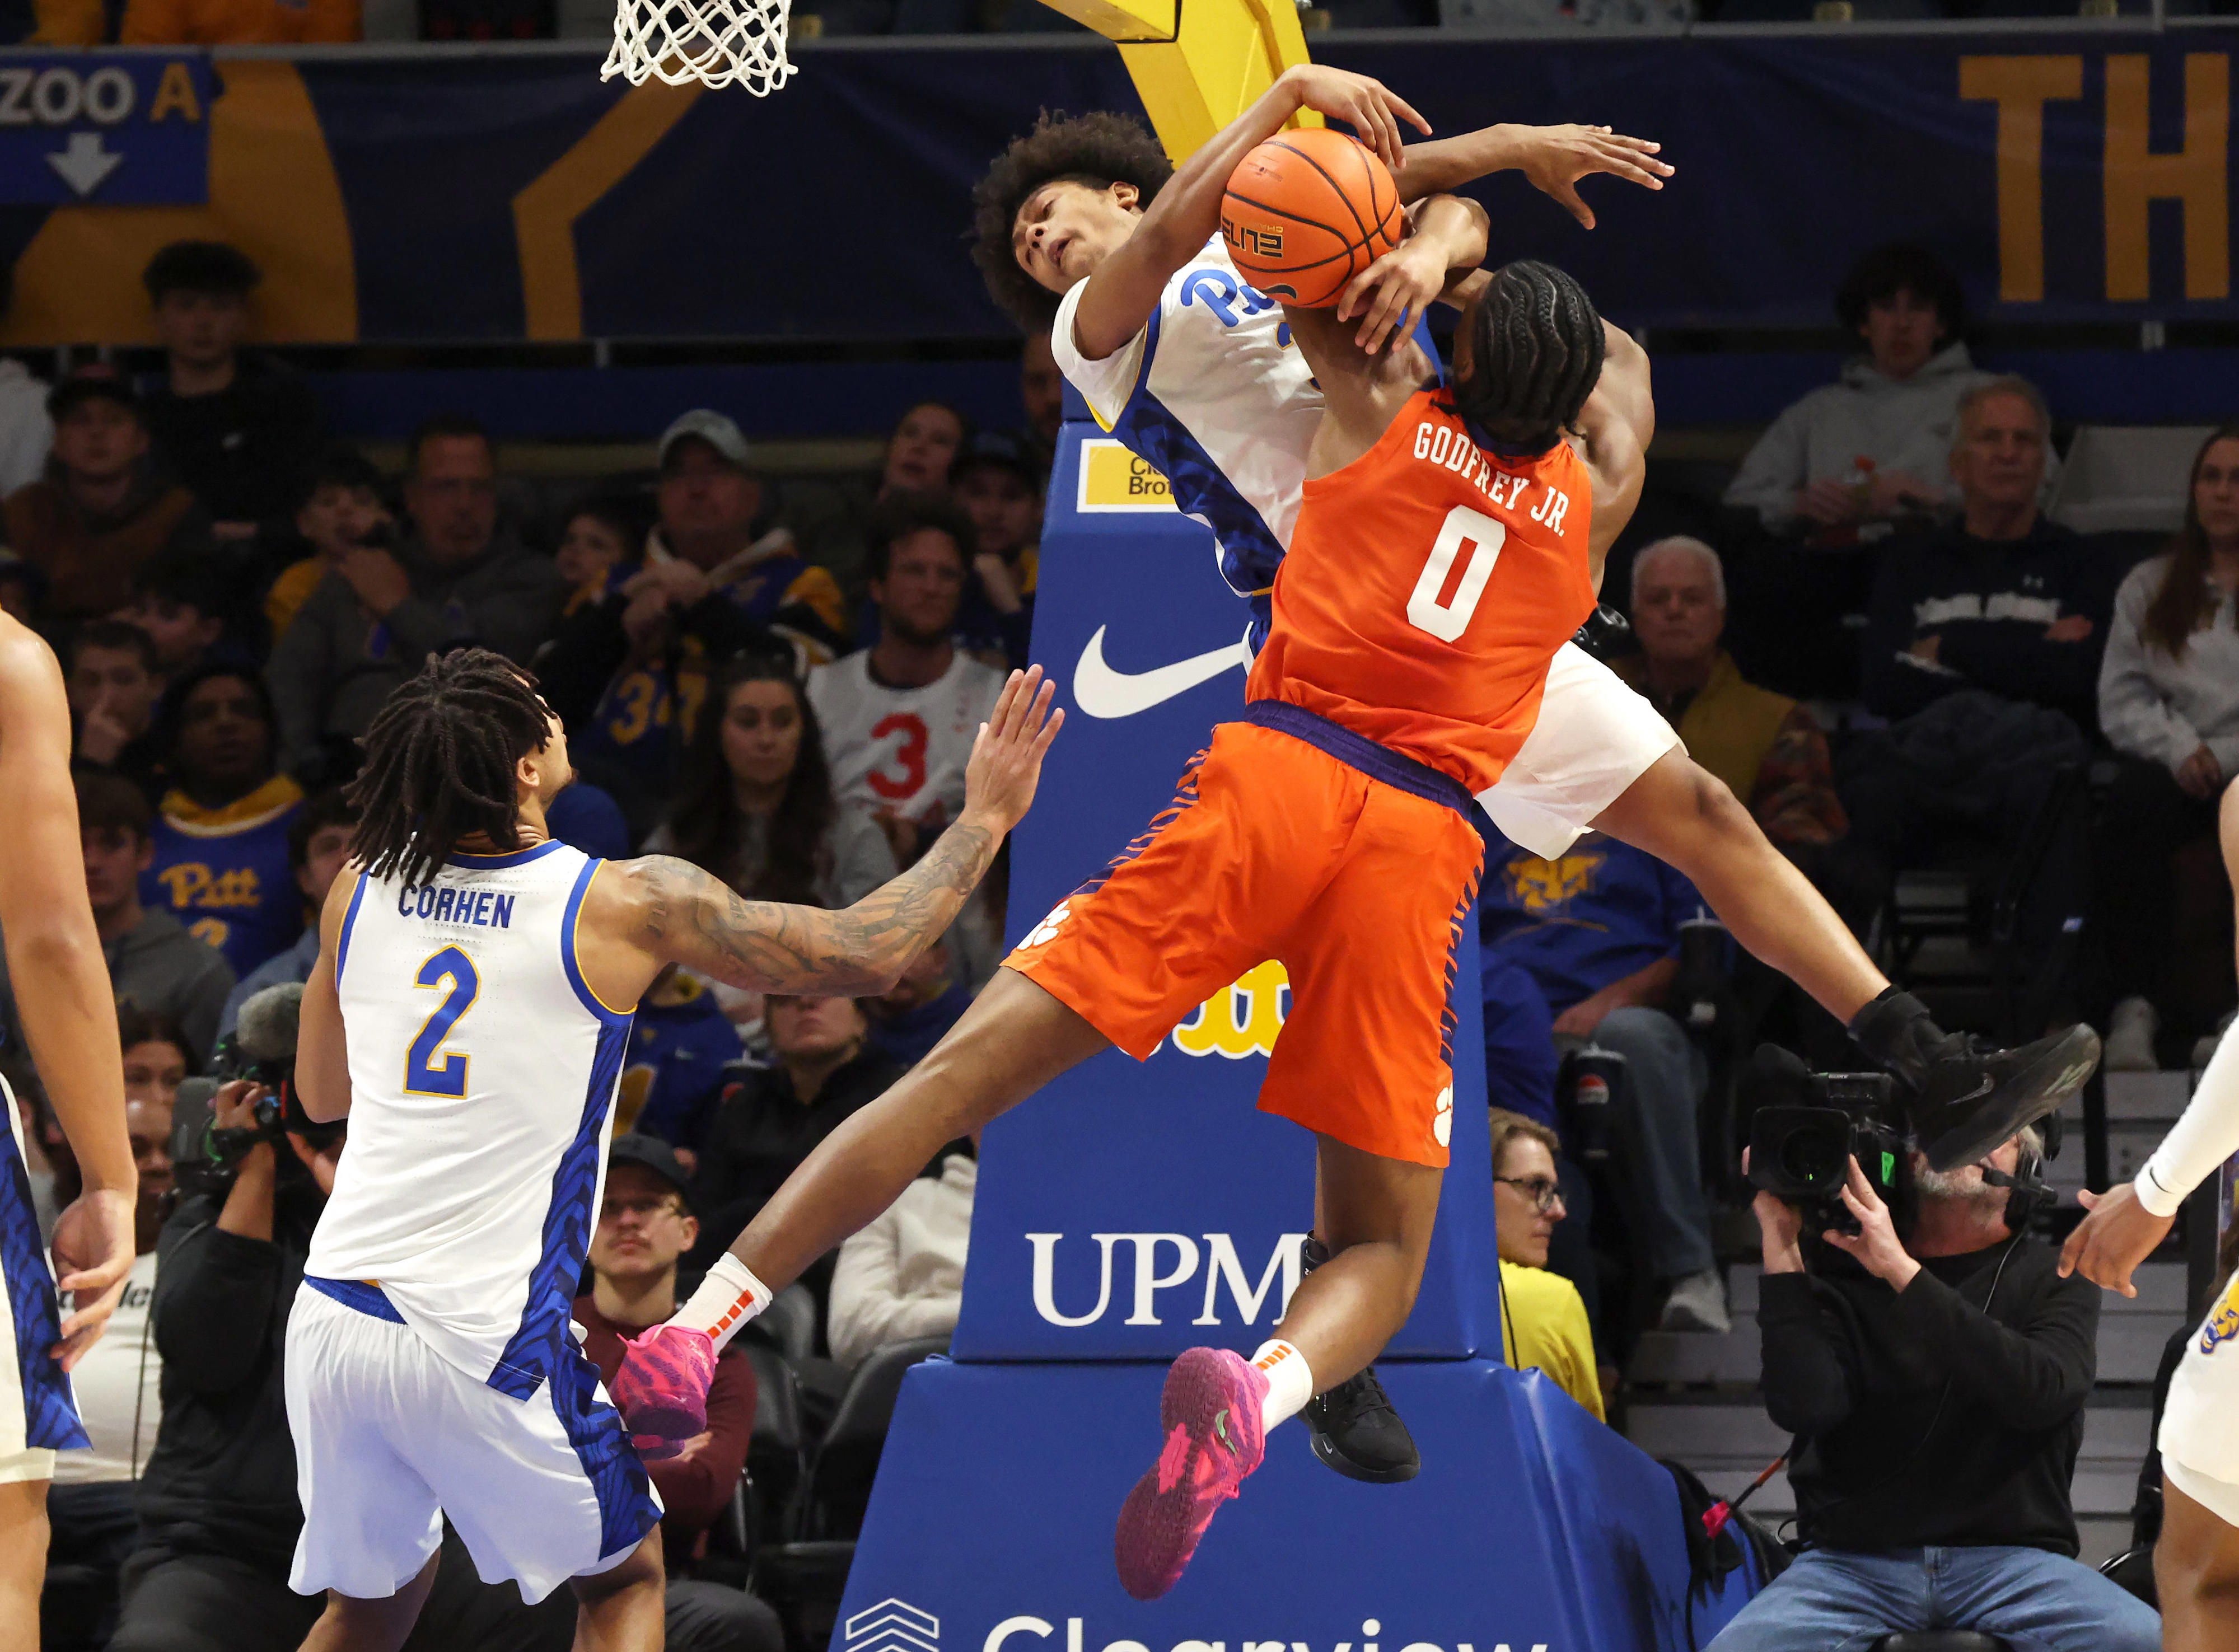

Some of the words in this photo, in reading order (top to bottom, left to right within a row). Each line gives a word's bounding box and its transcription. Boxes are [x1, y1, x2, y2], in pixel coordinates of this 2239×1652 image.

[0, 67, 136, 125] ZOO
[149, 63, 201, 122] A
[1958, 53, 2231, 301] TH
[1413, 422, 1530, 511] GODFREY
[1530, 485, 1569, 537] JR.
[1406, 504, 1506, 644] 0
[867, 710, 928, 801] 3
[157, 861, 261, 909] Pitt
[398, 884, 516, 929] CORHEN
[403, 943, 482, 1101] 2
[1024, 1232, 1309, 1328] UPM
